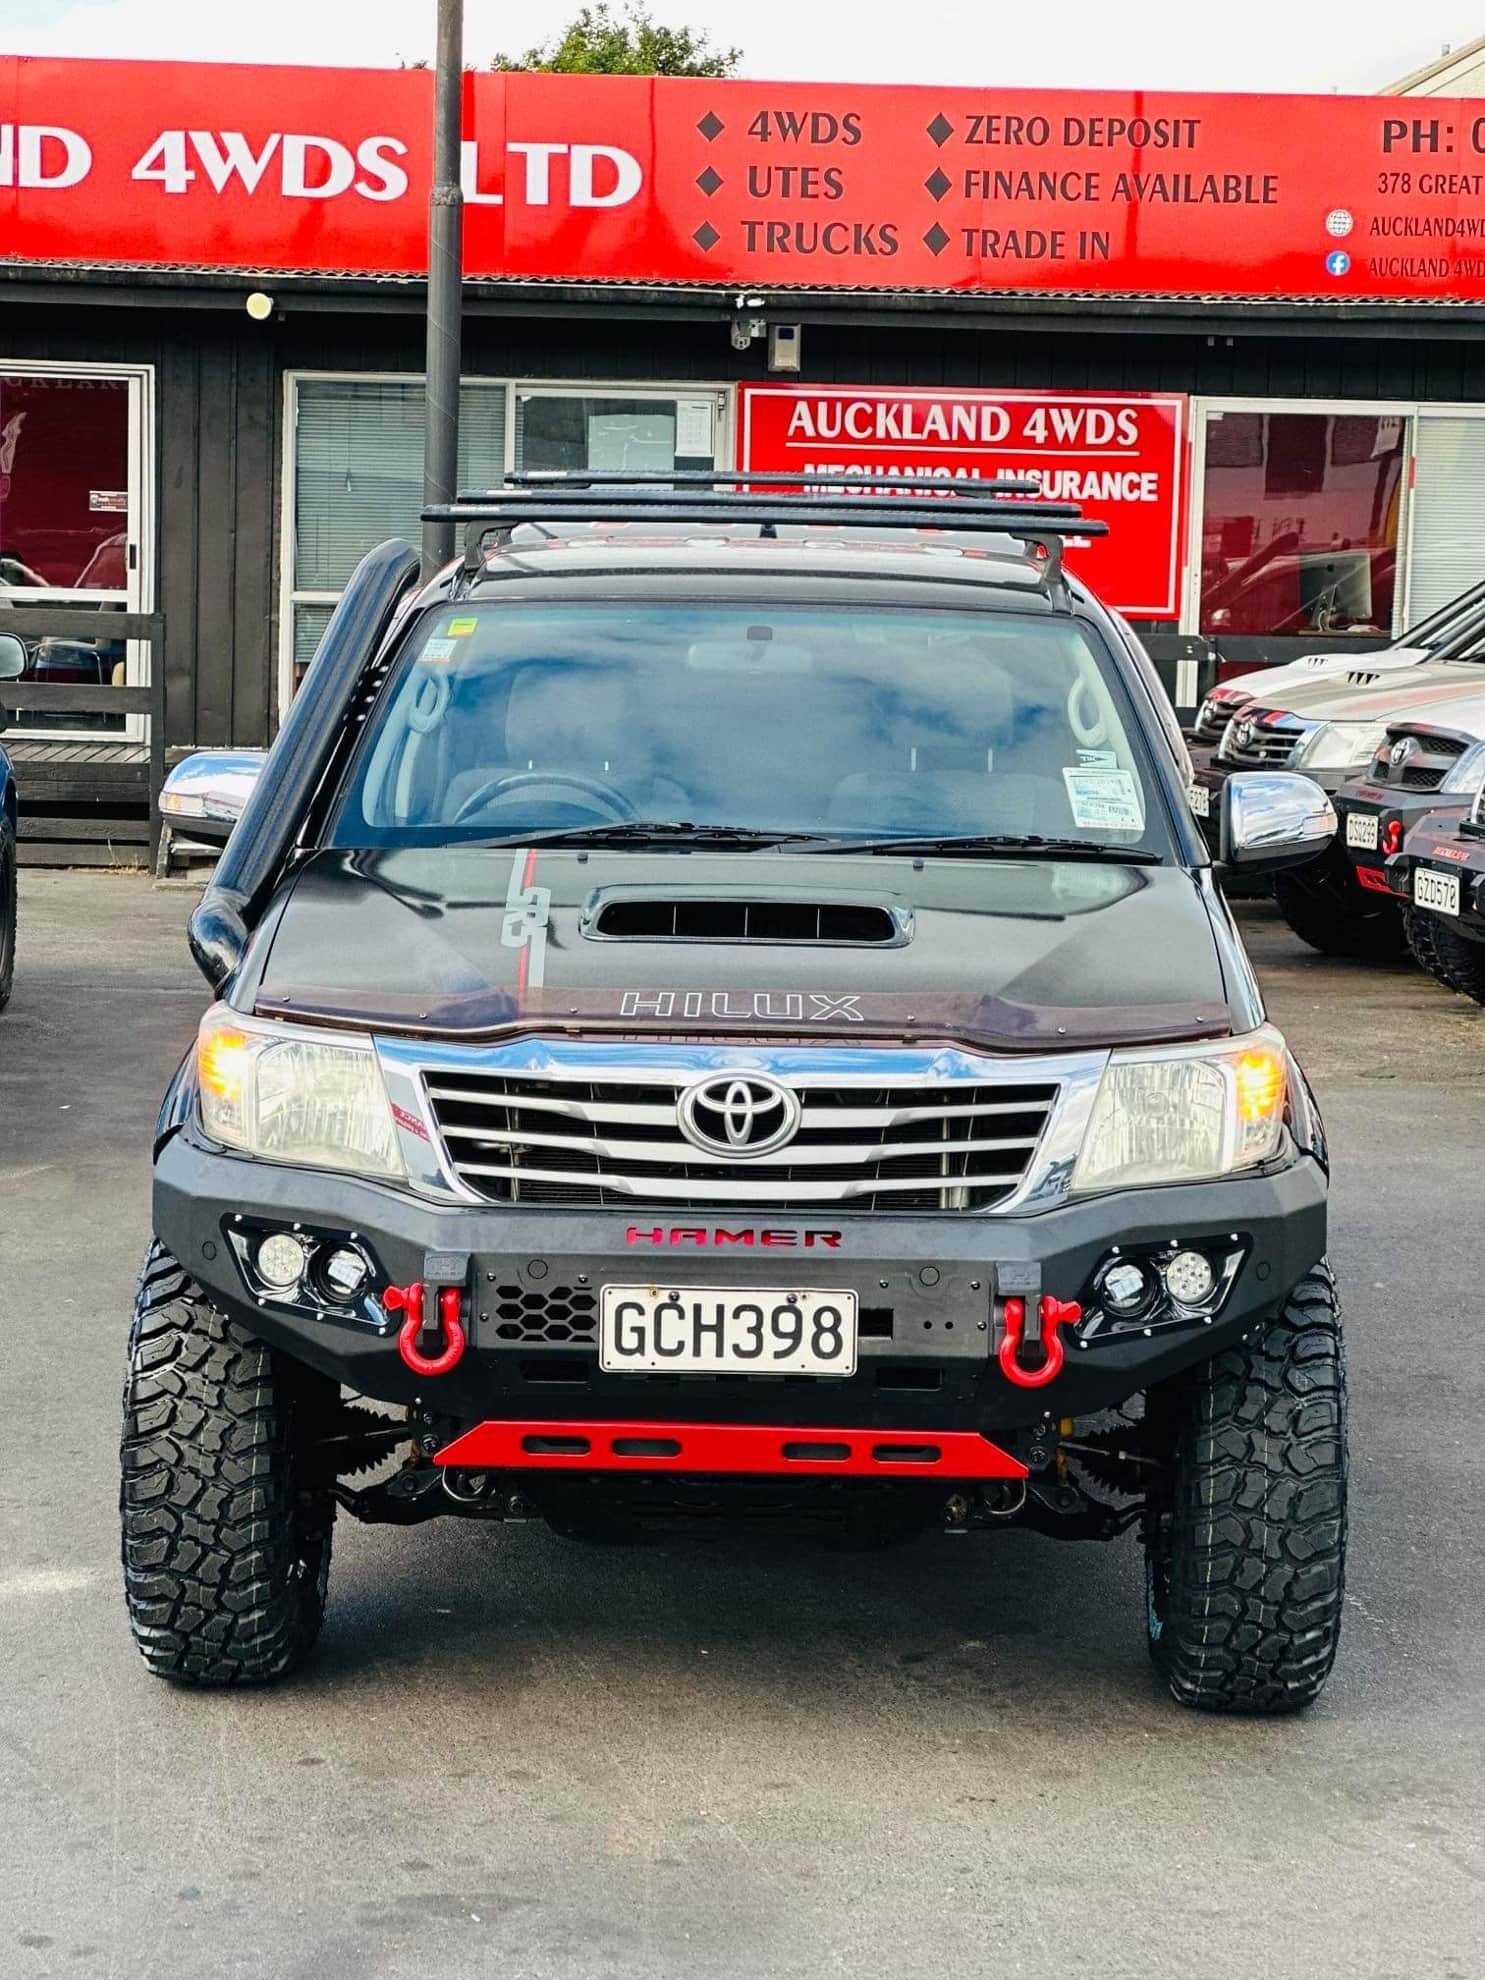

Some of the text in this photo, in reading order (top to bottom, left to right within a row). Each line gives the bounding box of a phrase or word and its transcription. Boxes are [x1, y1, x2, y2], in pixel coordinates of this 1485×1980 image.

[747, 110, 862, 146] 4WDS
[964, 114, 1201, 149] ZERO DEPOSIT
[1383, 119, 1453, 153] PH:
[131, 130, 409, 201] 4WDS
[460, 140, 643, 208] LTD
[747, 165, 844, 200] UTES
[1378, 172, 1483, 195] 378 GREAT
[963, 172, 1279, 204] FINANCE AVAILABLE
[741, 219, 899, 257] TRUCKS
[961, 227, 1110, 260] TRADE IN
[1369, 256, 1449, 278] AUCKLAND
[787, 400, 1139, 446] AUCKLAND 4WDS
[996, 468, 1158, 501] INSURANCE
[620, 992, 864, 1021] HILUX
[625, 1227, 842, 1248] HAMER
[614, 1301, 843, 1360] GCH398
